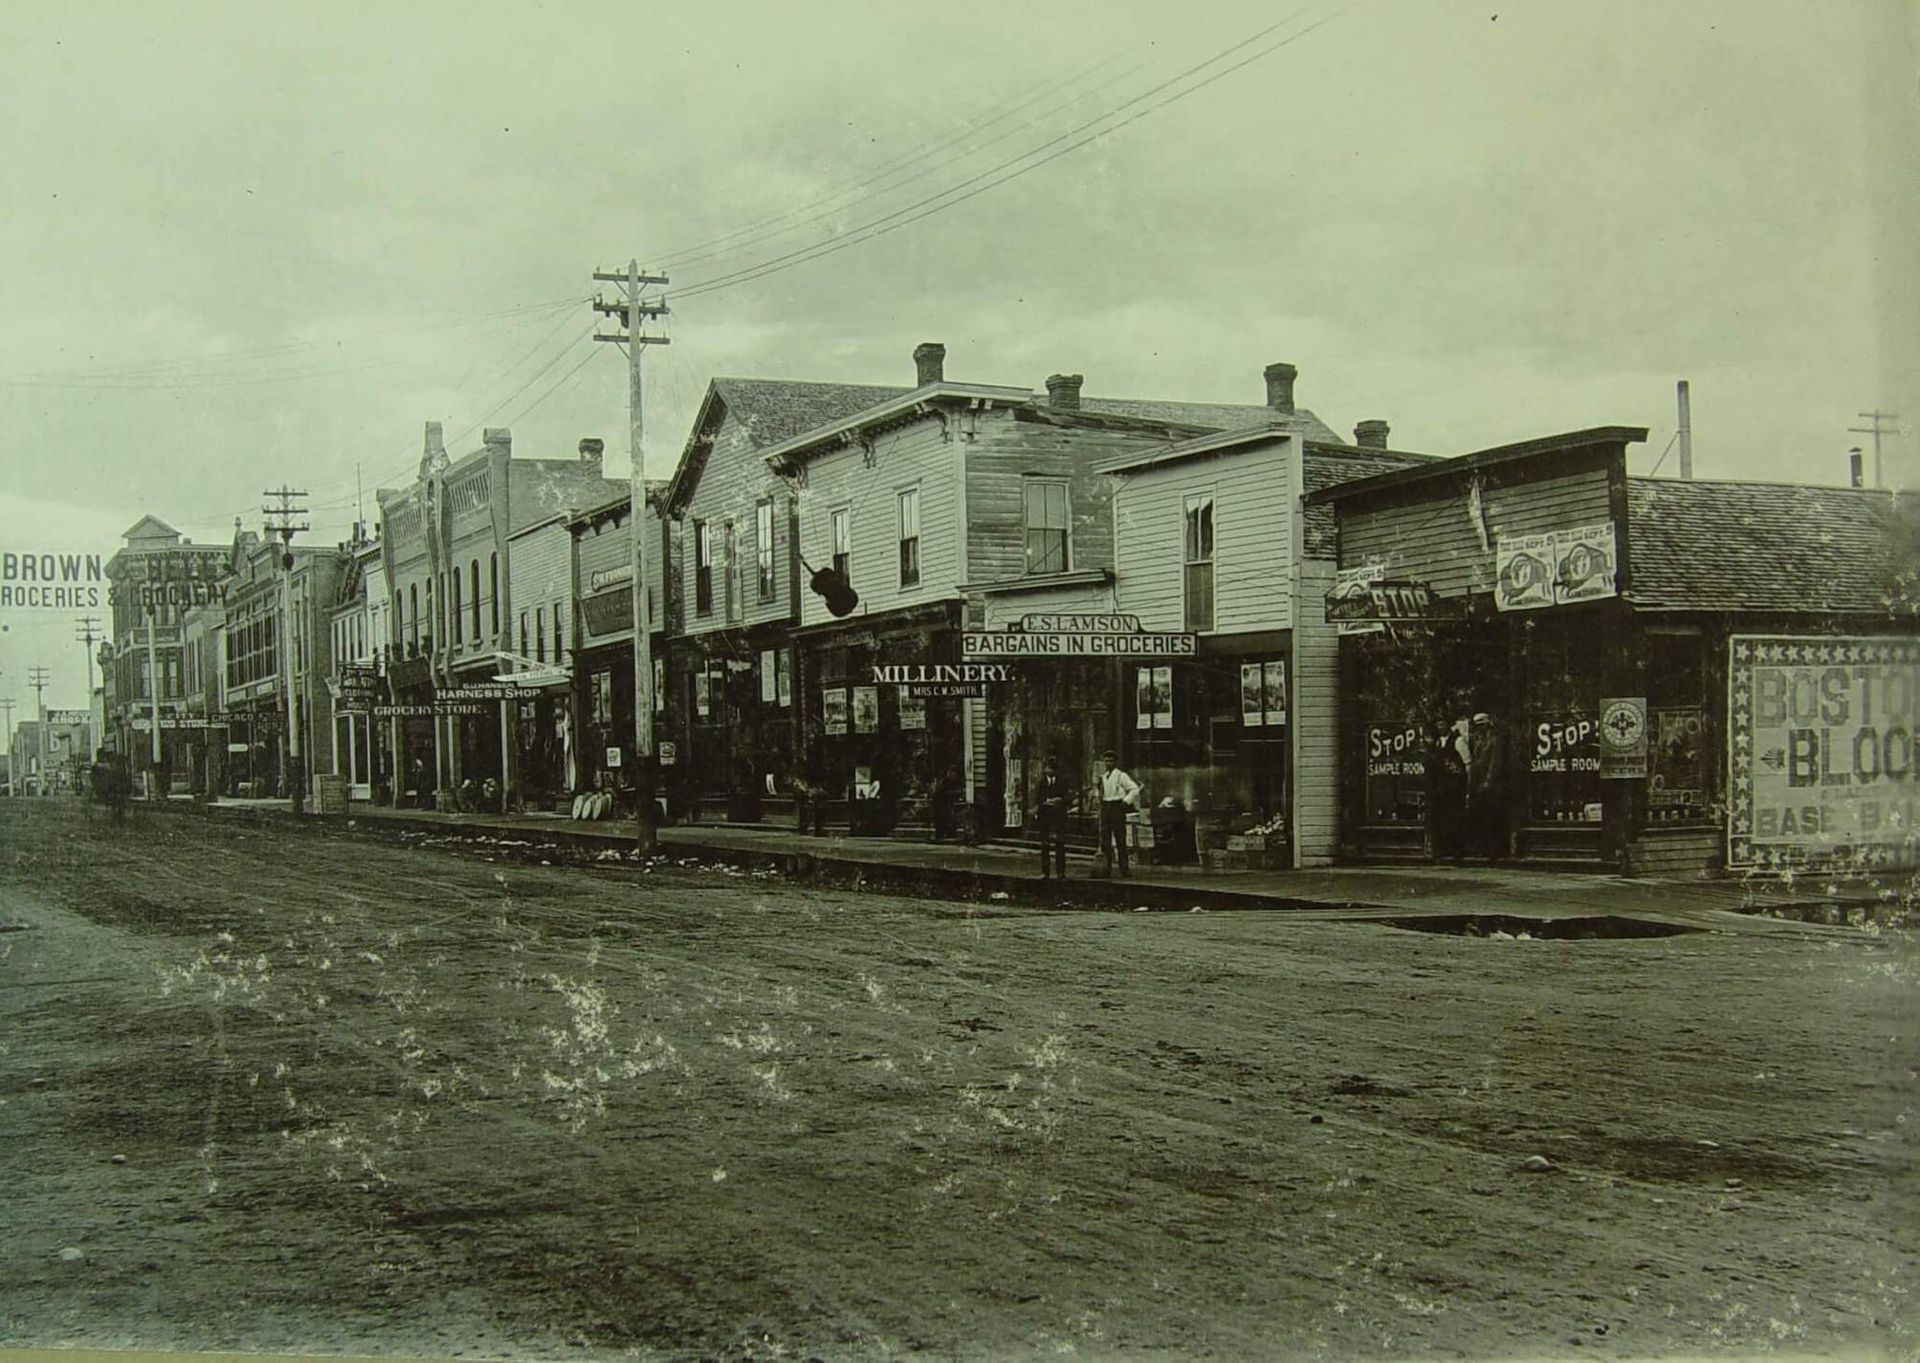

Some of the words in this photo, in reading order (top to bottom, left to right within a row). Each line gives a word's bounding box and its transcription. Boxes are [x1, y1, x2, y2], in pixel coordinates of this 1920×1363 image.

[3, 554, 101, 582] BROWN
[964, 635, 1059, 653] BARGAINS
[1067, 635, 1084, 653] IN
[436, 689, 502, 700] HARNESS
[1530, 758, 1567, 772] SAMPLE
[1571, 758, 1600, 772] ROOM
[1788, 727, 1920, 787] BLOO
[1756, 805, 1835, 838] BASE
